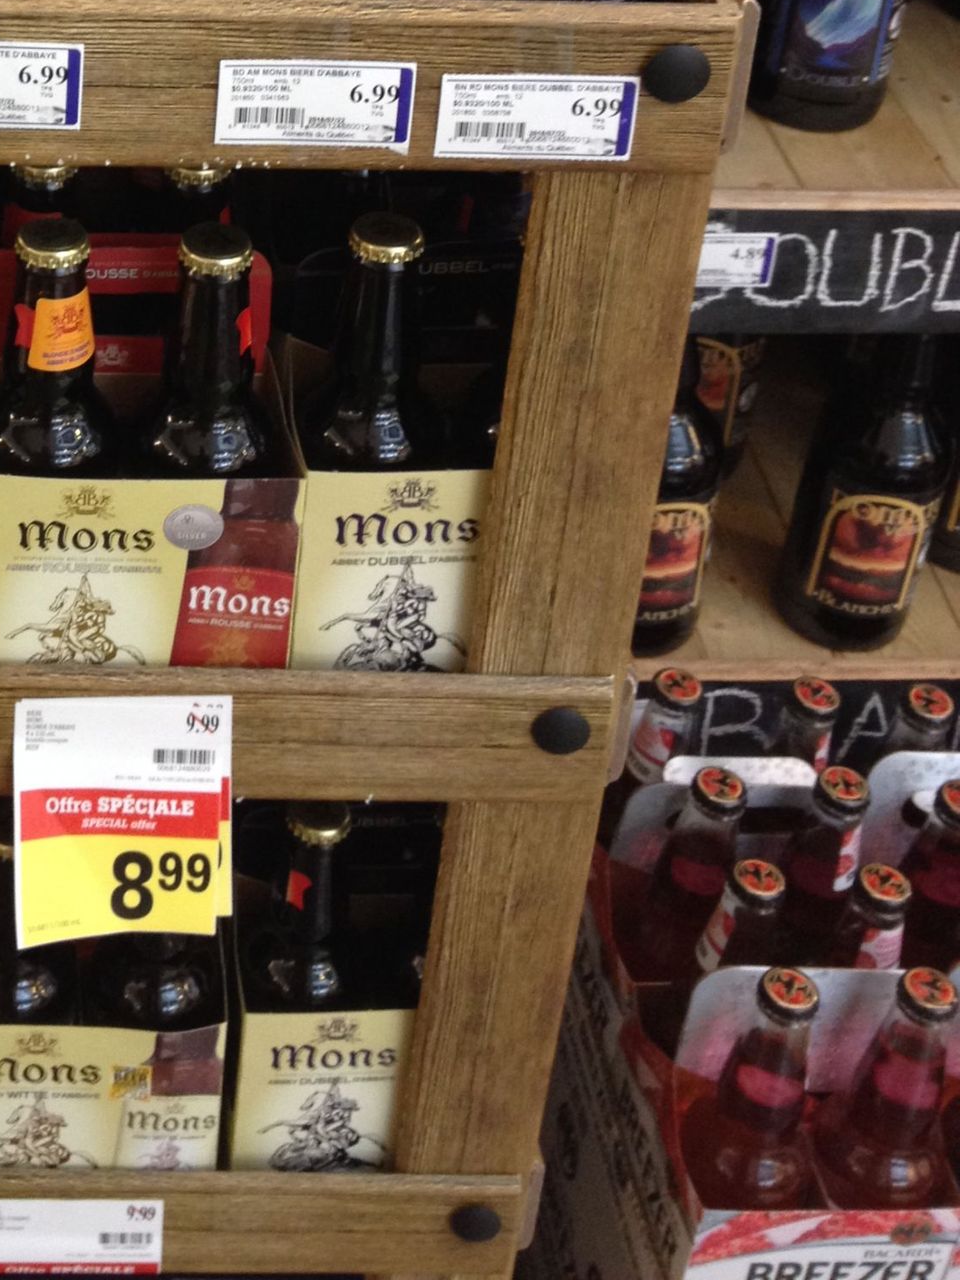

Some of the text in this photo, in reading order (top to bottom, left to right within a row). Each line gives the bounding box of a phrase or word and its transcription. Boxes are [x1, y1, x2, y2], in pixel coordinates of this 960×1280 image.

[13, 51, 57, 60] D'ABBAYE
[18, 65, 68, 84] 6.99
[262, 69, 287, 77] MONS
[317, 69, 361, 77] D'ABBAYE
[350, 83, 400, 103] 6.99
[484, 84, 509, 92] MONS
[571, 98, 621, 117] 6.99
[416, 262, 489, 276] UBBEL
[18, 519, 156, 553] Mons
[334, 511, 480, 547] Mons
[368, 554, 426, 567] DUBBEL
[189, 585, 290, 617] Mons
[45, 795, 194, 817] Offre SPÉCIALE
[81, 818, 157, 831] SPECIAL offer
[271, 1043, 396, 1070] Mons
[6, 1089, 48, 1099] WITTE
[127, 1109, 217, 1131] Mons
